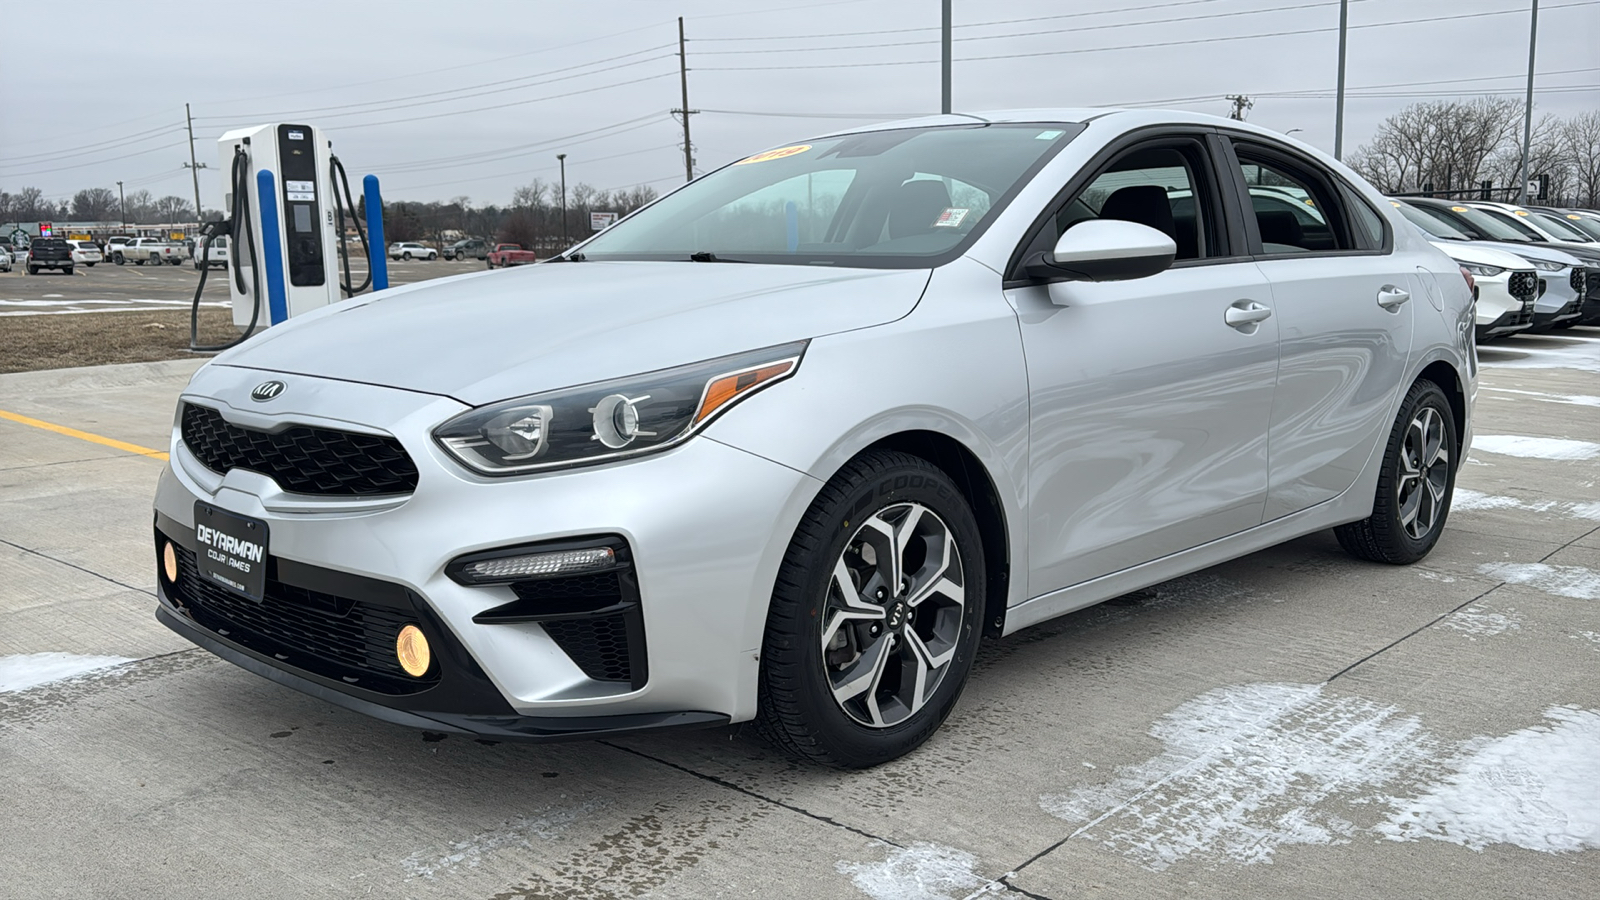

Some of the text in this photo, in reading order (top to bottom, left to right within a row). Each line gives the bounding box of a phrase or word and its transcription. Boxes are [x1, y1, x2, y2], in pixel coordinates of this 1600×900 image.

[253, 383, 280, 397] KIA
[197, 524, 263, 563] DEYARMAN
[228, 557, 251, 573] AMES
[890, 602, 904, 625] KIA
